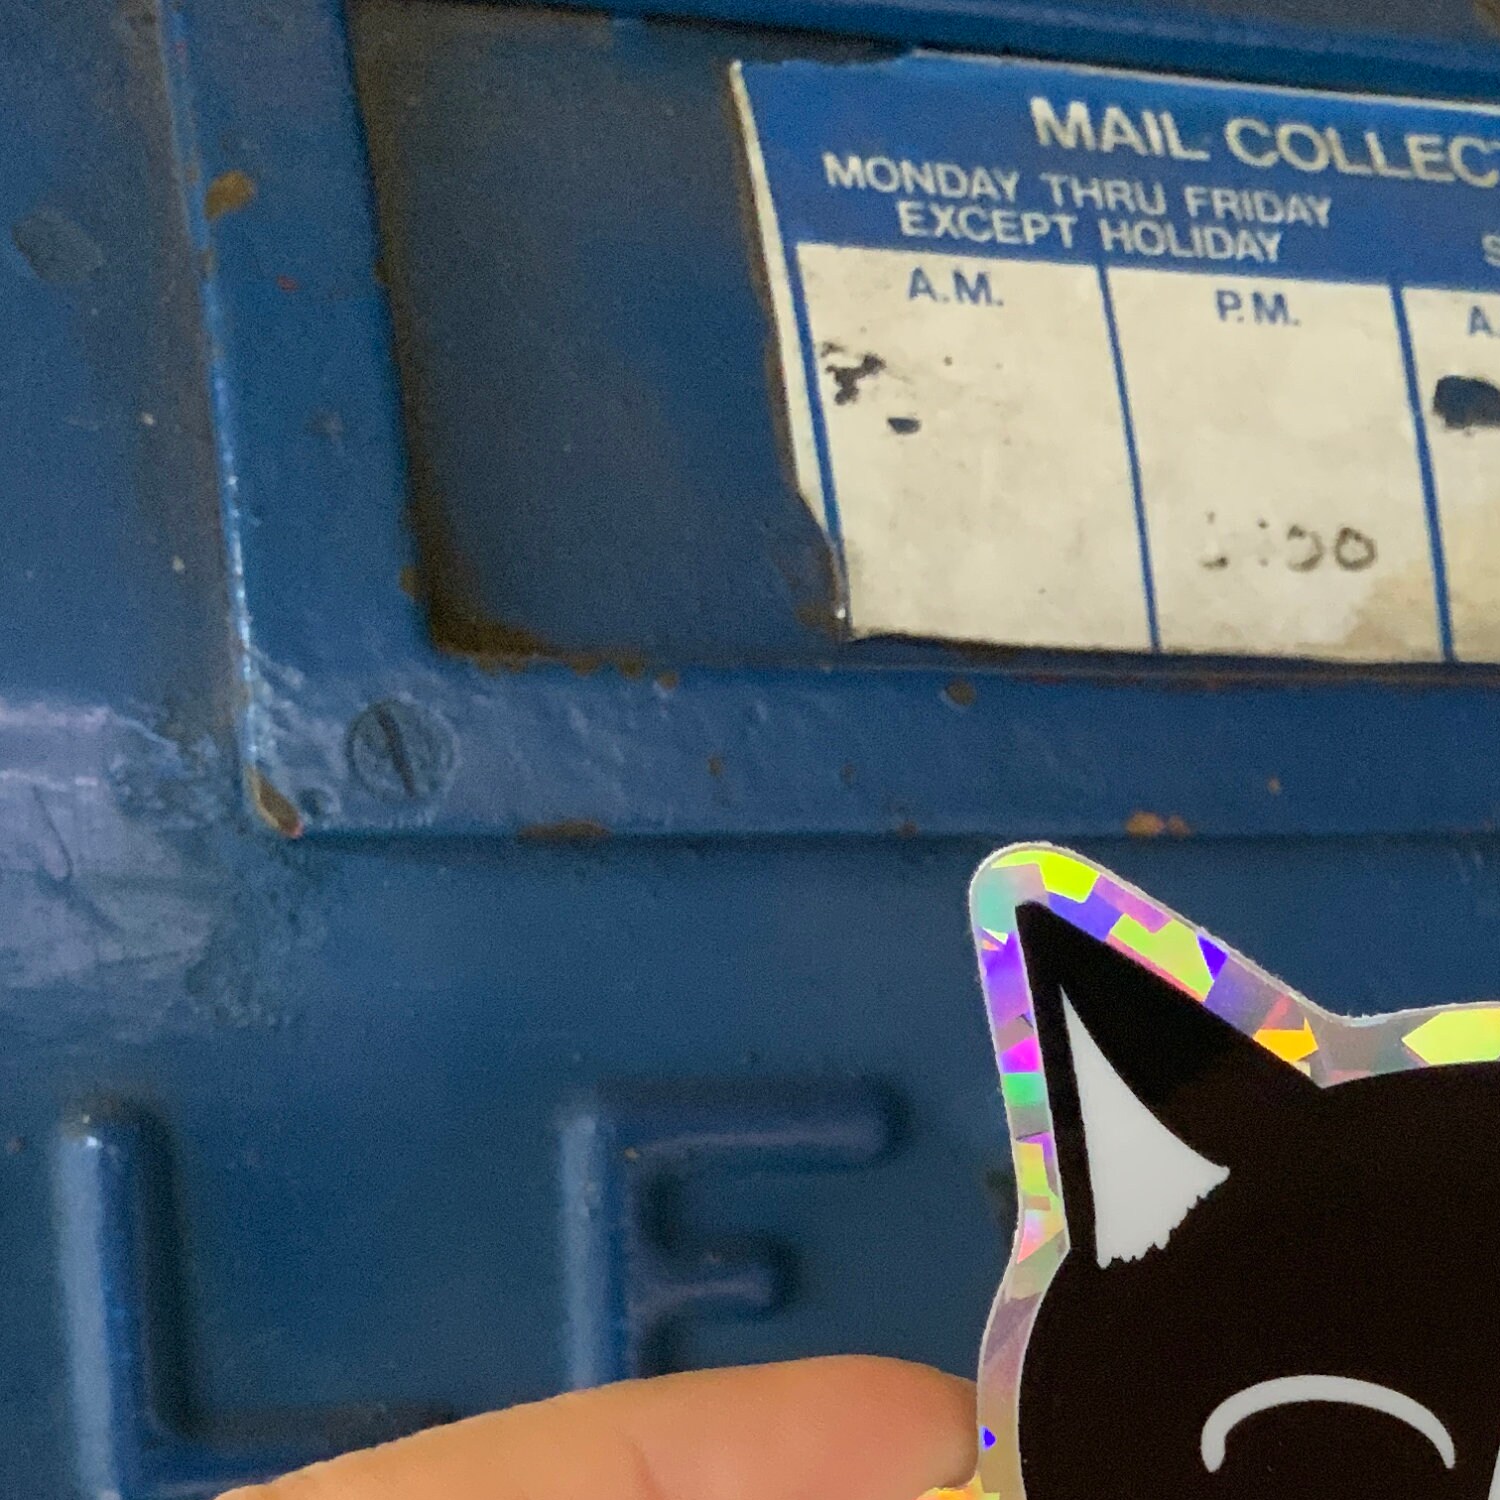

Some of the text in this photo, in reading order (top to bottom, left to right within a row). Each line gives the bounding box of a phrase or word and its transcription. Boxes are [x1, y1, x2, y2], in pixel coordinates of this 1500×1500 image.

[1030, 97, 1211, 161] MAIL
[822, 151, 1332, 229] MONDAY THRU FRIDAY
[898, 201, 1283, 264] EXCEPT HOLIDAY
[907, 267, 1005, 308] A.M.
[1215, 288, 1302, 327] P.M.
